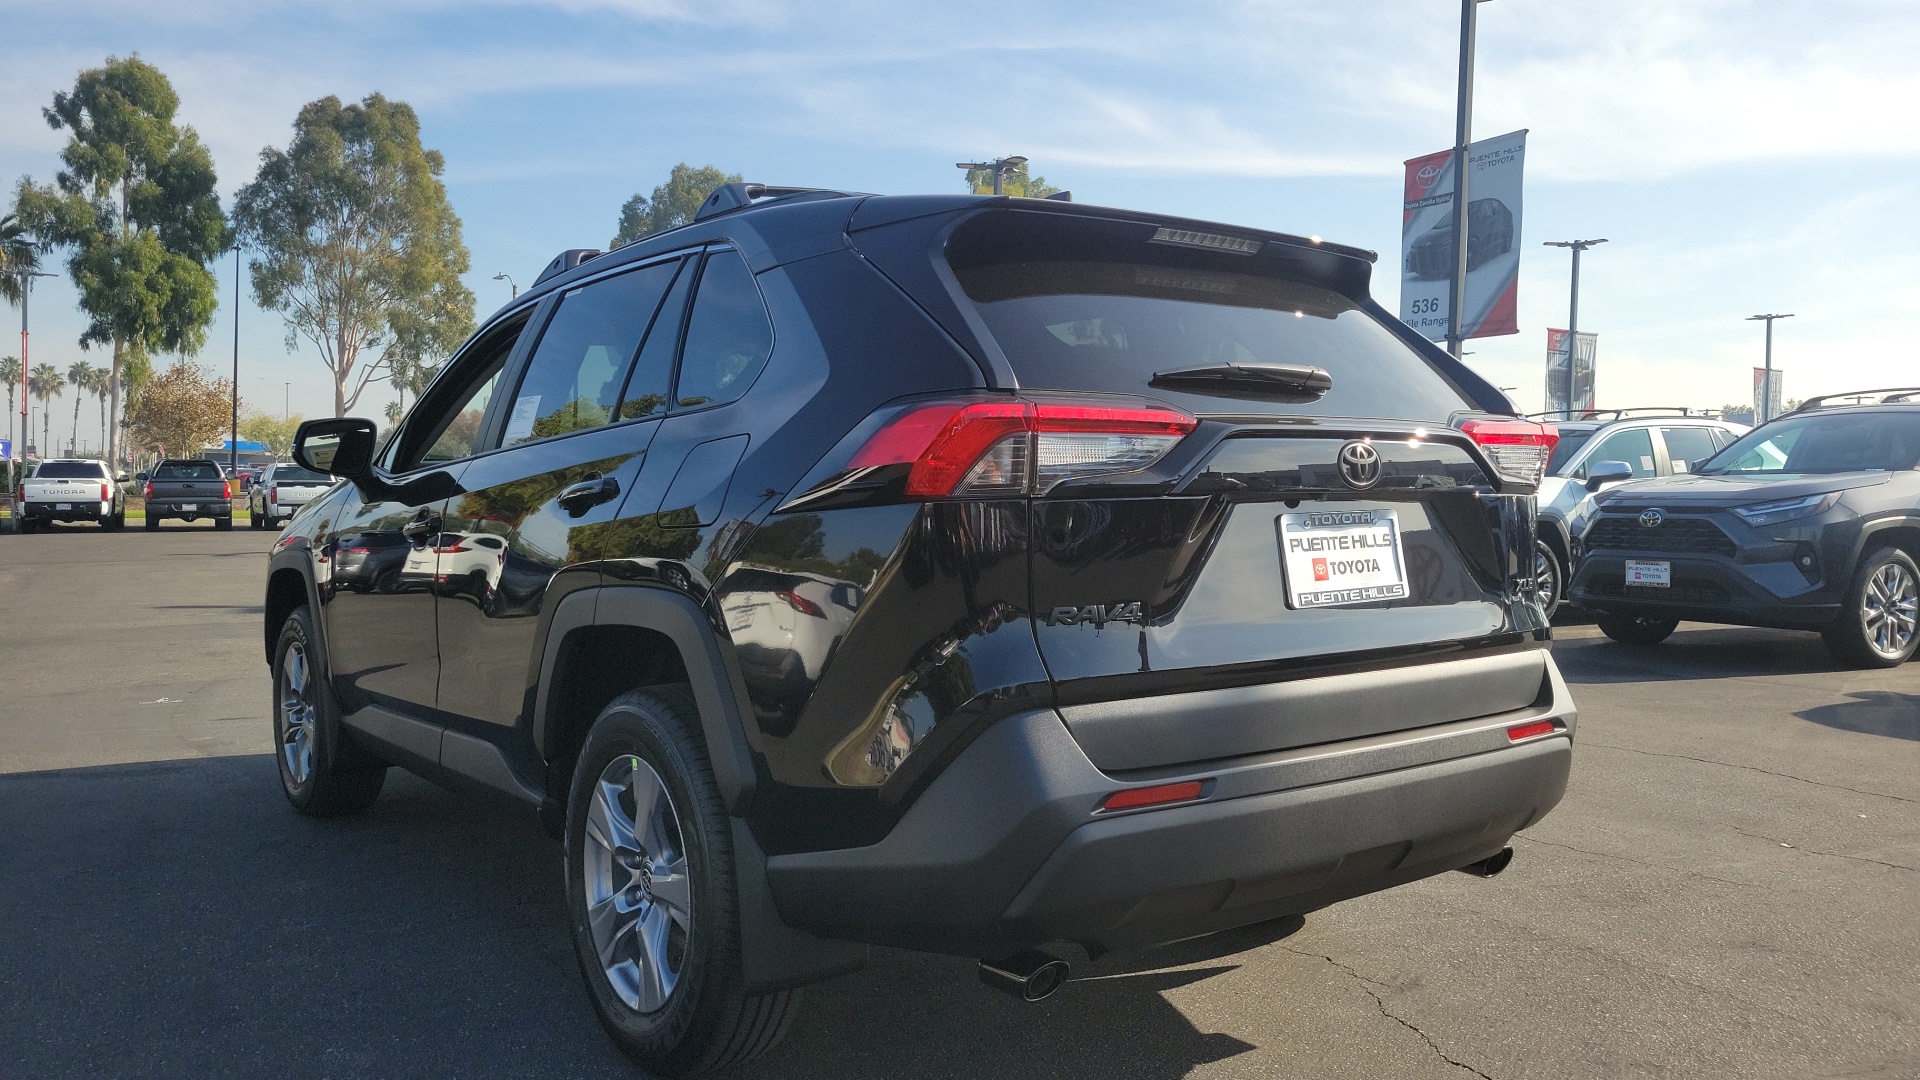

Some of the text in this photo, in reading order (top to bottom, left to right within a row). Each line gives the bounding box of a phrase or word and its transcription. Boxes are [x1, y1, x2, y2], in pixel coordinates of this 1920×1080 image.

[1487, 155, 1515, 168] TOYOTA
[1420, 198, 1435, 206] Corolla
[1411, 298, 1439, 315] 536
[1311, 512, 1372, 526] TOYOTA
[1289, 533, 1392, 553] PUENTE HILLS
[1330, 558, 1381, 575] TOYOTA
[1299, 585, 1404, 605] PUENTE HILLS
[1046, 601, 1142, 627] RAV4
